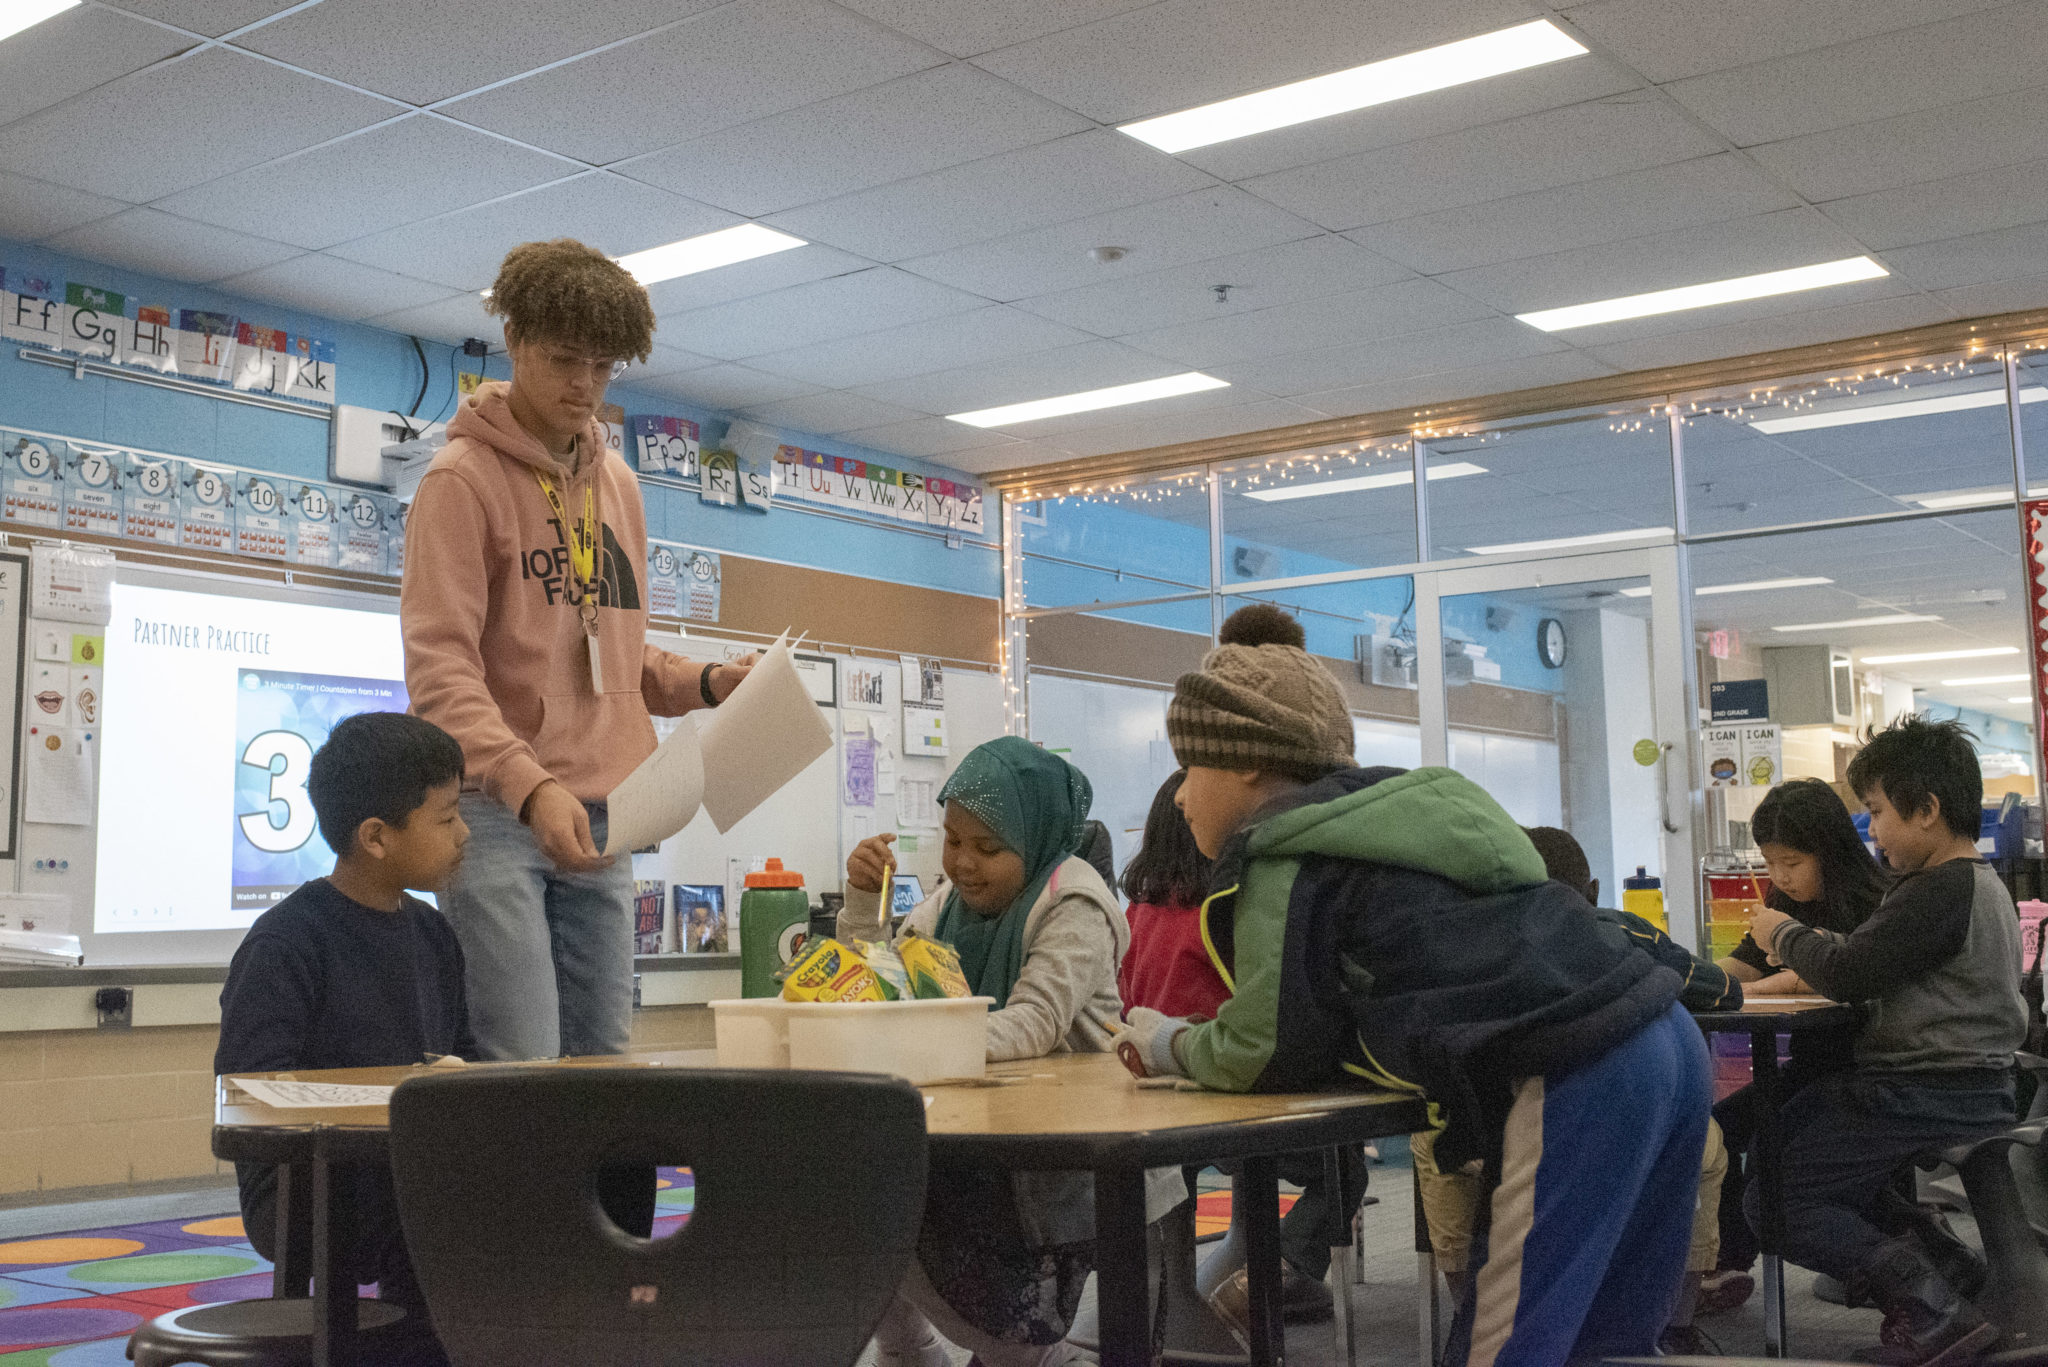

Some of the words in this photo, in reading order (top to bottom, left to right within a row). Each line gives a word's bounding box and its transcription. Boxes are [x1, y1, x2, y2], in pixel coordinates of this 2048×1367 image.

[17, 294, 57, 330] Ff
[72, 308, 116, 358] Gg
[133, 319, 170, 357] Hh
[246, 346, 276, 393] Jj
[297, 355, 327, 390] Kk
[29, 451, 41, 468] 6
[645, 434, 668, 472] Pp
[668, 436, 699, 478] Qq
[91, 460, 101, 478] 7
[149, 470, 159, 488] 8
[709, 466, 731, 492] Rr
[777, 460, 799, 487] Tt
[810, 467, 831, 494] Uu
[204, 479, 214, 497] 9
[253, 488, 273, 506] 10
[749, 473, 768, 498] Ss
[843, 474, 861, 499] Vv
[869, 479, 896, 507] Ww
[83, 494, 105, 503] seven
[306, 496, 324, 514] 11
[903, 488, 924, 513] Xx
[932, 493, 952, 526] Yy
[256, 518, 269, 527] ten
[357, 505, 374, 522] 12
[961, 500, 978, 524] Zz
[658, 555, 672, 570] 19
[695, 560, 710, 576] 20
[270, 681, 294, 691] Minute
[296, 683, 315, 692] Timer
[320, 685, 357, 695] Countdown
[358, 688, 374, 696] from
[374, 689, 379, 697] 3
[380, 689, 392, 697] Min
[1711, 685, 1726, 693] 203
[1713, 710, 1726, 718] 2ND
[1726, 708, 1749, 716] GRADE
[1709, 731, 1714, 741] I
[1716, 731, 1736, 741] CAN
[1747, 730, 1751, 740] I
[1753, 729, 1774, 739] CAN
[238, 729, 318, 854] 3
[236, 892, 257, 901] Watch
[797, 949, 836, 983] Crayola
[840, 975, 875, 1002] AYONS
